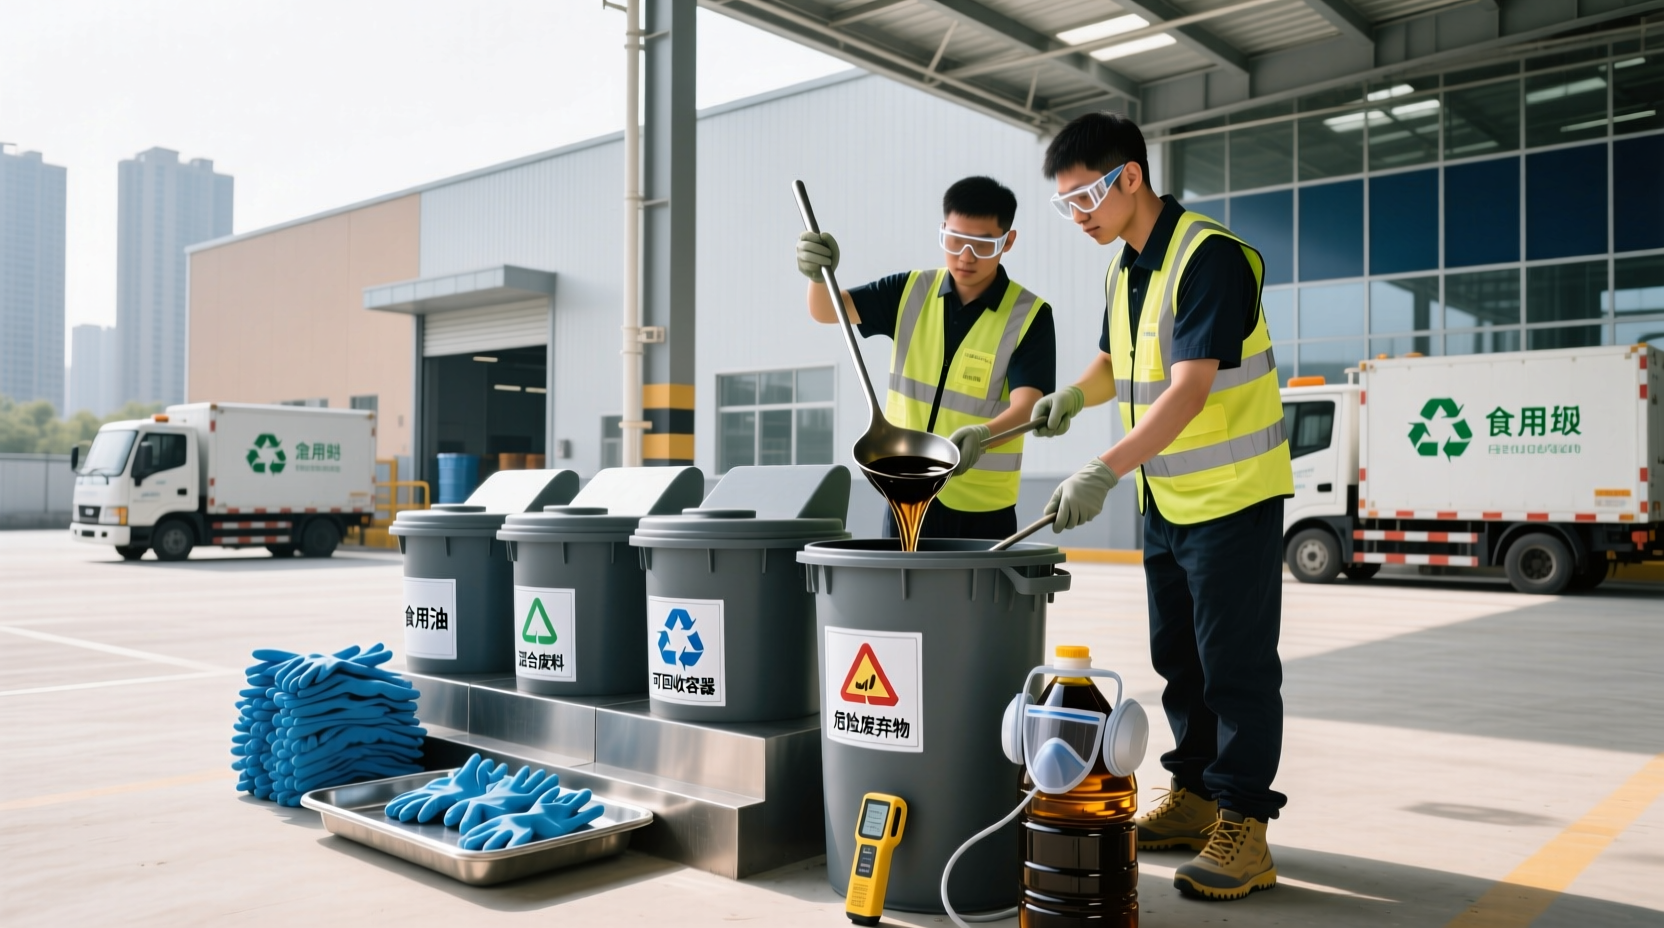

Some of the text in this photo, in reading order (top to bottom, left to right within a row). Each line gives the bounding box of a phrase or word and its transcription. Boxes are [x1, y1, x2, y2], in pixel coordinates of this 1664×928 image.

[405, 605, 448, 630] 食用油
[652, 672, 716, 696] 可回收容器
[834, 710, 910, 739] 危险废弃物
